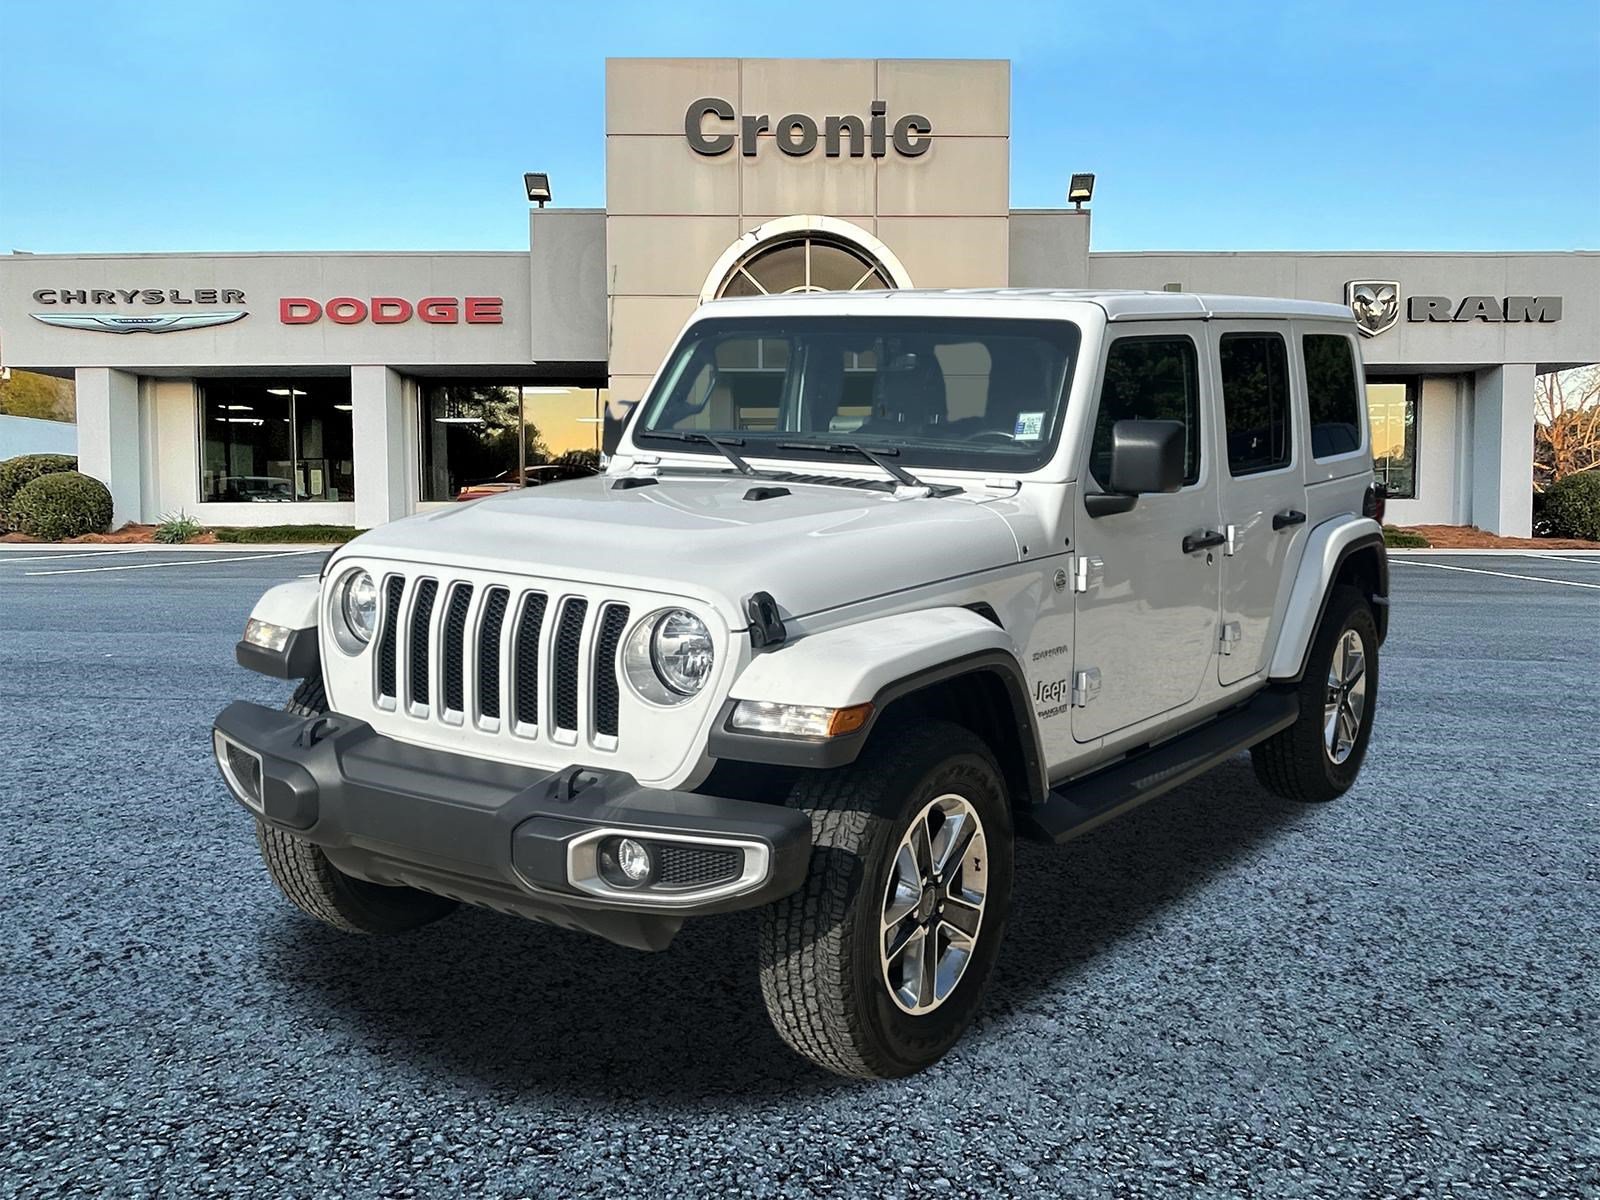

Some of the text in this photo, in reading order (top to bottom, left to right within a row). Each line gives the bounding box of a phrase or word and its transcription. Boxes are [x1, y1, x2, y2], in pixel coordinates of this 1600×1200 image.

[685, 97, 932, 157] Cronic
[32, 289, 247, 304] CHRYSLER
[1407, 296, 1563, 322] RAM
[280, 297, 503, 324] DODGE
[1033, 679, 1067, 703] Jeep
